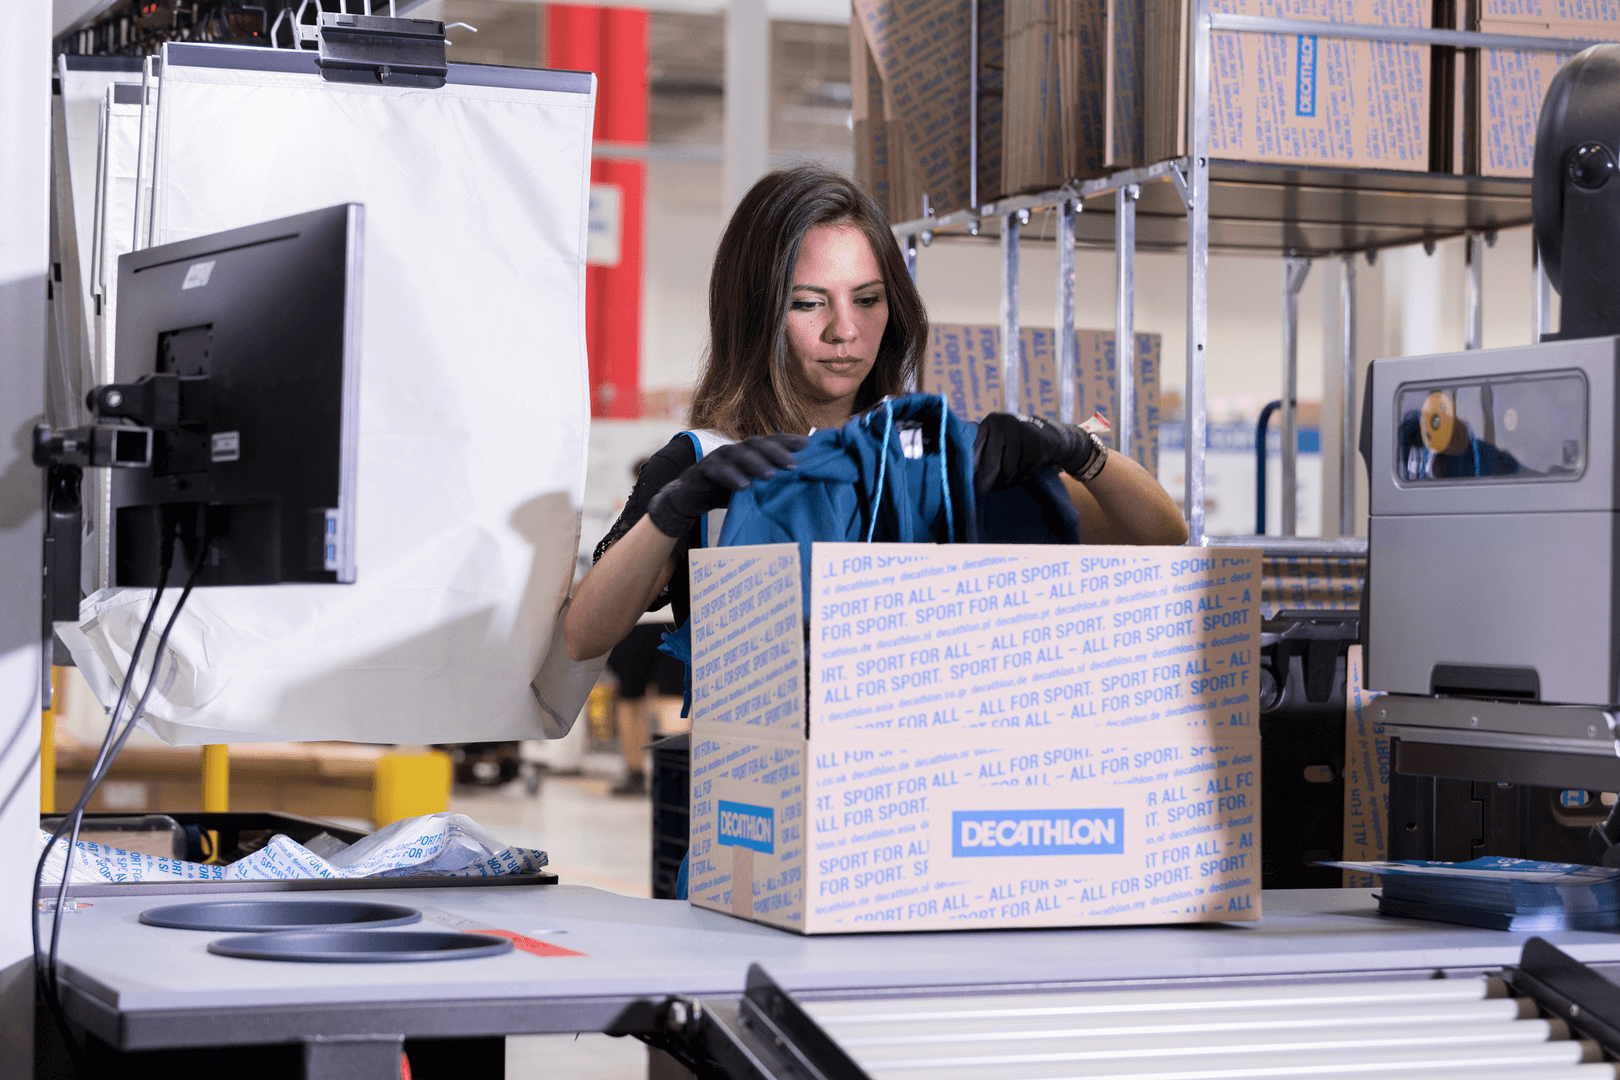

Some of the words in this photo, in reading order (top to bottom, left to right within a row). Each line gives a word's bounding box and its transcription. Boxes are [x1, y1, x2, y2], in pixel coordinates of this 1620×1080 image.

[822, 597, 869, 621] SPORT
[874, 592, 903, 611] FOR
[908, 586, 936, 605] ALL
[955, 578, 983, 596] ALL
[988, 571, 1016, 590] FOR
[1021, 561, 1071, 584] SPORT.
[842, 556, 872, 574] FOR
[822, 622, 851, 642] FOR
[856, 612, 907, 635] SPORT.
[916, 601, 965, 624] SPORT
[969, 595, 998, 614] FOR
[1003, 590, 1030, 608] ALL
[1049, 581, 1076, 599] ALL
[1081, 575, 1109, 594] FOR
[1114, 564, 1163, 587] SPORT.
[856, 653, 905, 677] SPORT
[910, 647, 940, 667] FOR
[944, 642, 971, 660] ALL
[991, 633, 1018, 652] ALL
[1023, 626, 1051, 645] FOR
[1056, 616, 1105, 639] SPORT.
[1113, 605, 1160, 628] SPORT
[1165, 599, 1193, 619] FOR
[1197, 594, 1224, 613] ALL
[824, 686, 851, 704] ALL
[857, 679, 886, 698] FOR
[891, 667, 942, 692] SPORT.
[950, 656, 998, 680] SPORT
[1003, 651, 1032, 670] FOR
[1036, 645, 1063, 663] ALL
[1082, 637, 1109, 655] ALL
[1114, 630, 1142, 648] FOR
[1146, 619, 1196, 642] SPORT.
[1202, 608, 1250, 632] SPORT
[932, 708, 959, 726] ALL
[979, 699, 1005, 716] ALL
[1011, 691, 1039, 710] FOR
[1044, 680, 1093, 704] SPORT.
[1101, 669, 1148, 693] SPORT
[1153, 663, 1181, 682] FOR
[1184, 657, 1212, 677] ALL
[1071, 701, 1097, 719] ALL
[1102, 694, 1130, 713] FOR
[1134, 683, 1184, 707] SPORT.
[1190, 672, 1237, 696] SPORT
[843, 782, 893, 807] SPORT
[898, 776, 927, 796] FOR
[932, 770, 959, 787] ALL
[978, 761, 1005, 779] ALL
[1010, 754, 1039, 773] FOR
[844, 808, 873, 828] FOR
[878, 796, 929, 821] SPORT.
[1070, 763, 1096, 781] ALL
[1101, 756, 1129, 775] FOR
[1134, 747, 1183, 769] SPORT.
[720, 810, 772, 844] DECATHLON
[819, 851, 868, 876] SPORT
[874, 844, 903, 864] FOR
[1162, 786, 1188, 804] ALL
[1206, 776, 1233, 796] ALL
[820, 877, 849, 897] FOR
[854, 864, 905, 889] SPORT.
[1167, 799, 1214, 823] SPORT
[1218, 793, 1247, 813] FOR
[961, 818, 1115, 847] DECATHLON
[908, 899, 937, 919] FOR
[942, 894, 969, 912] ALL
[989, 883, 1015, 902] ALL
[1162, 845, 1190, 865] FOR
[1195, 839, 1221, 858] ALL
[1035, 895, 1061, 913] ALL
[1080, 884, 1107, 903] ALL
[1111, 877, 1139, 896] FOR
[1144, 865, 1193, 889] SPORT.
[1200, 852, 1248, 877] SPORT
[1227, 893, 1253, 913] ALL
